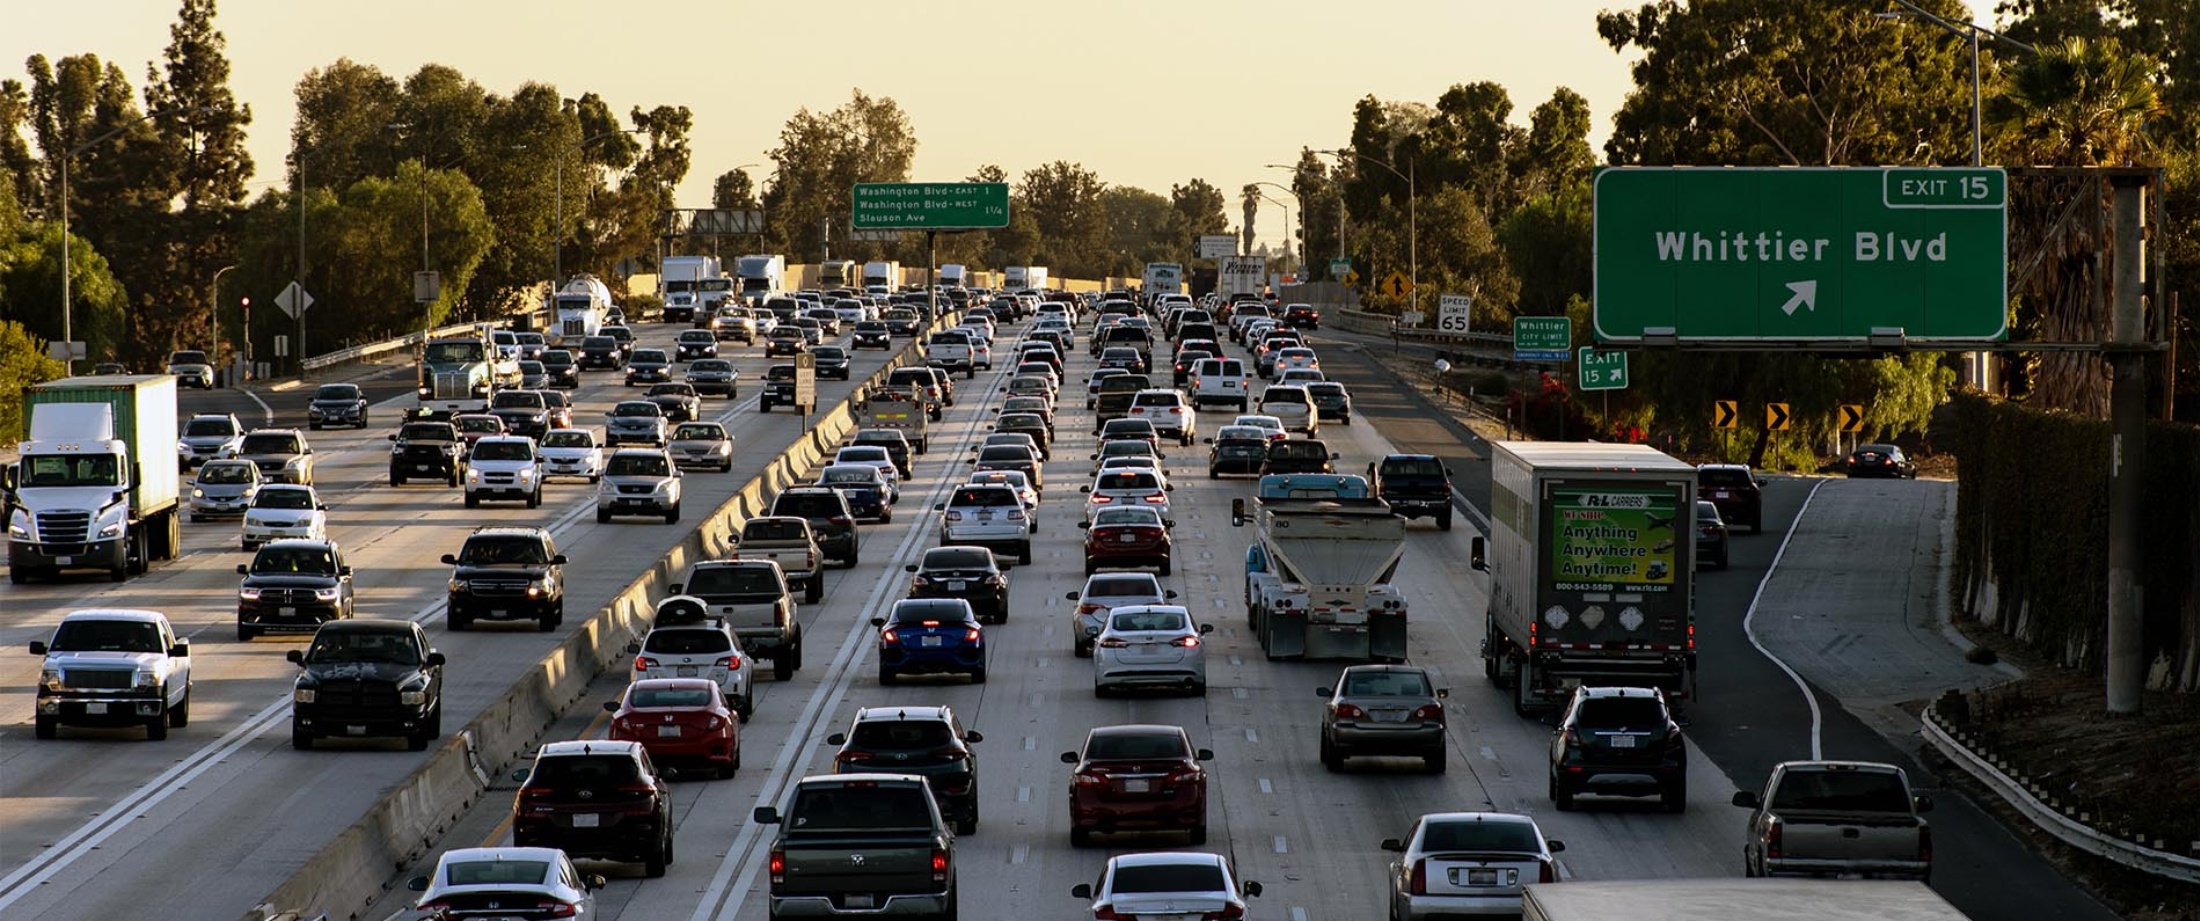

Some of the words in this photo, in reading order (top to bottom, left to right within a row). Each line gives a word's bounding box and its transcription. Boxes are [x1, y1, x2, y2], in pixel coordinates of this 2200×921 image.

[860, 188, 919, 197] Washington
[1902, 180, 1947, 196] EXIT
[1959, 176, 1989, 199] 15
[860, 201, 919, 210] Washington
[924, 201, 947, 209] Blvd
[860, 214, 901, 222] Slauson
[906, 214, 925, 222] Ave
[1656, 231, 1829, 261] Whittier
[1856, 231, 1947, 261] Blvd
[1442, 297, 1469, 306] SPEED
[1444, 306, 1466, 314] LIMIT
[1442, 316, 1466, 331] 65
[1520, 321, 1565, 330] Whittier
[1585, 352, 1620, 364] EXIT
[1584, 370, 1600, 382] 15
[1611, 495, 1643, 507] CARRIERS
[1563, 525, 1638, 541] Anything
[1562, 543, 1646, 558] Anywhere
[1562, 562, 1637, 577] Anytime!
